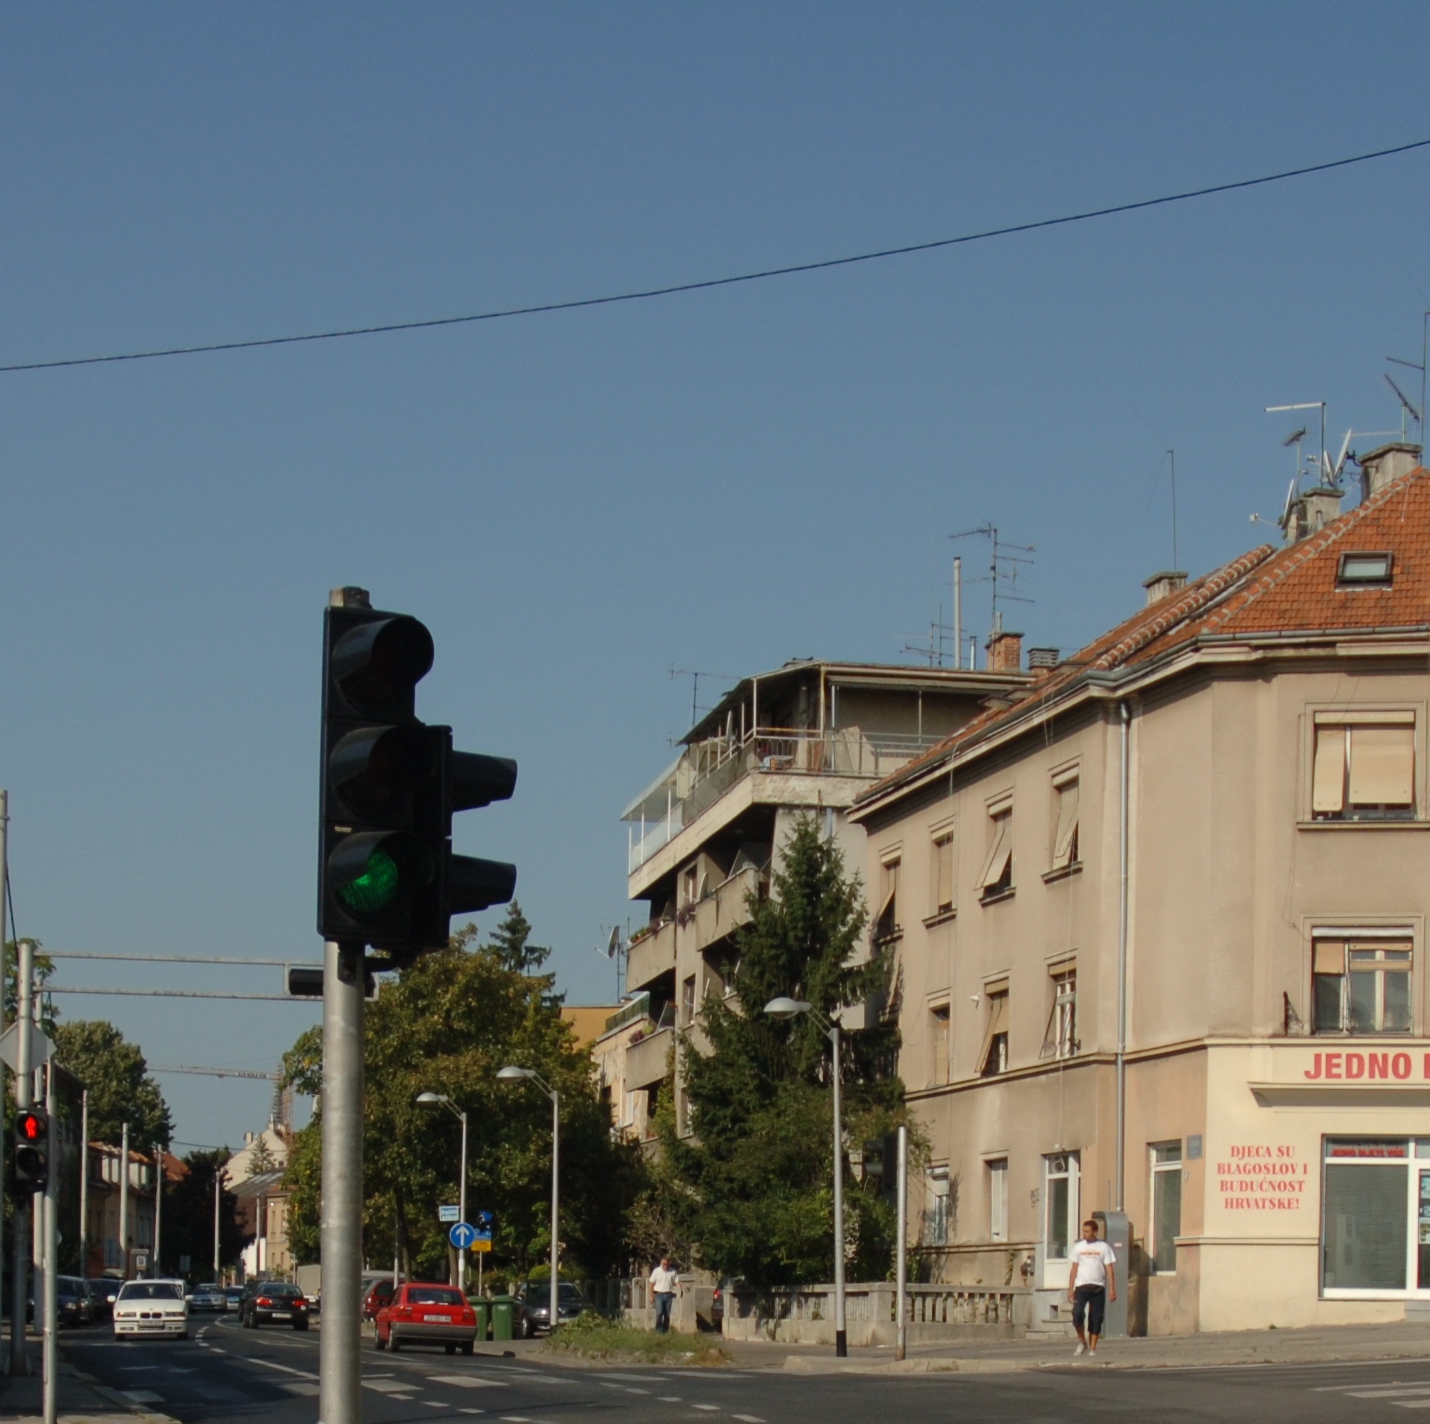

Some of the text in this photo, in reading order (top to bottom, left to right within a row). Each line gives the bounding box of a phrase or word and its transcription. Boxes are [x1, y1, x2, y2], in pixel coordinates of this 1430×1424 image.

[1304, 1053, 1412, 1079] JEDNO
[1231, 1146, 1295, 1160] DJECA SU
[1217, 1163, 1308, 1175] BLAGOSLOV I
[1220, 1177, 1305, 1192] BUDUĆNOST
[1224, 1198, 1300, 1209] HRVATSKE!
